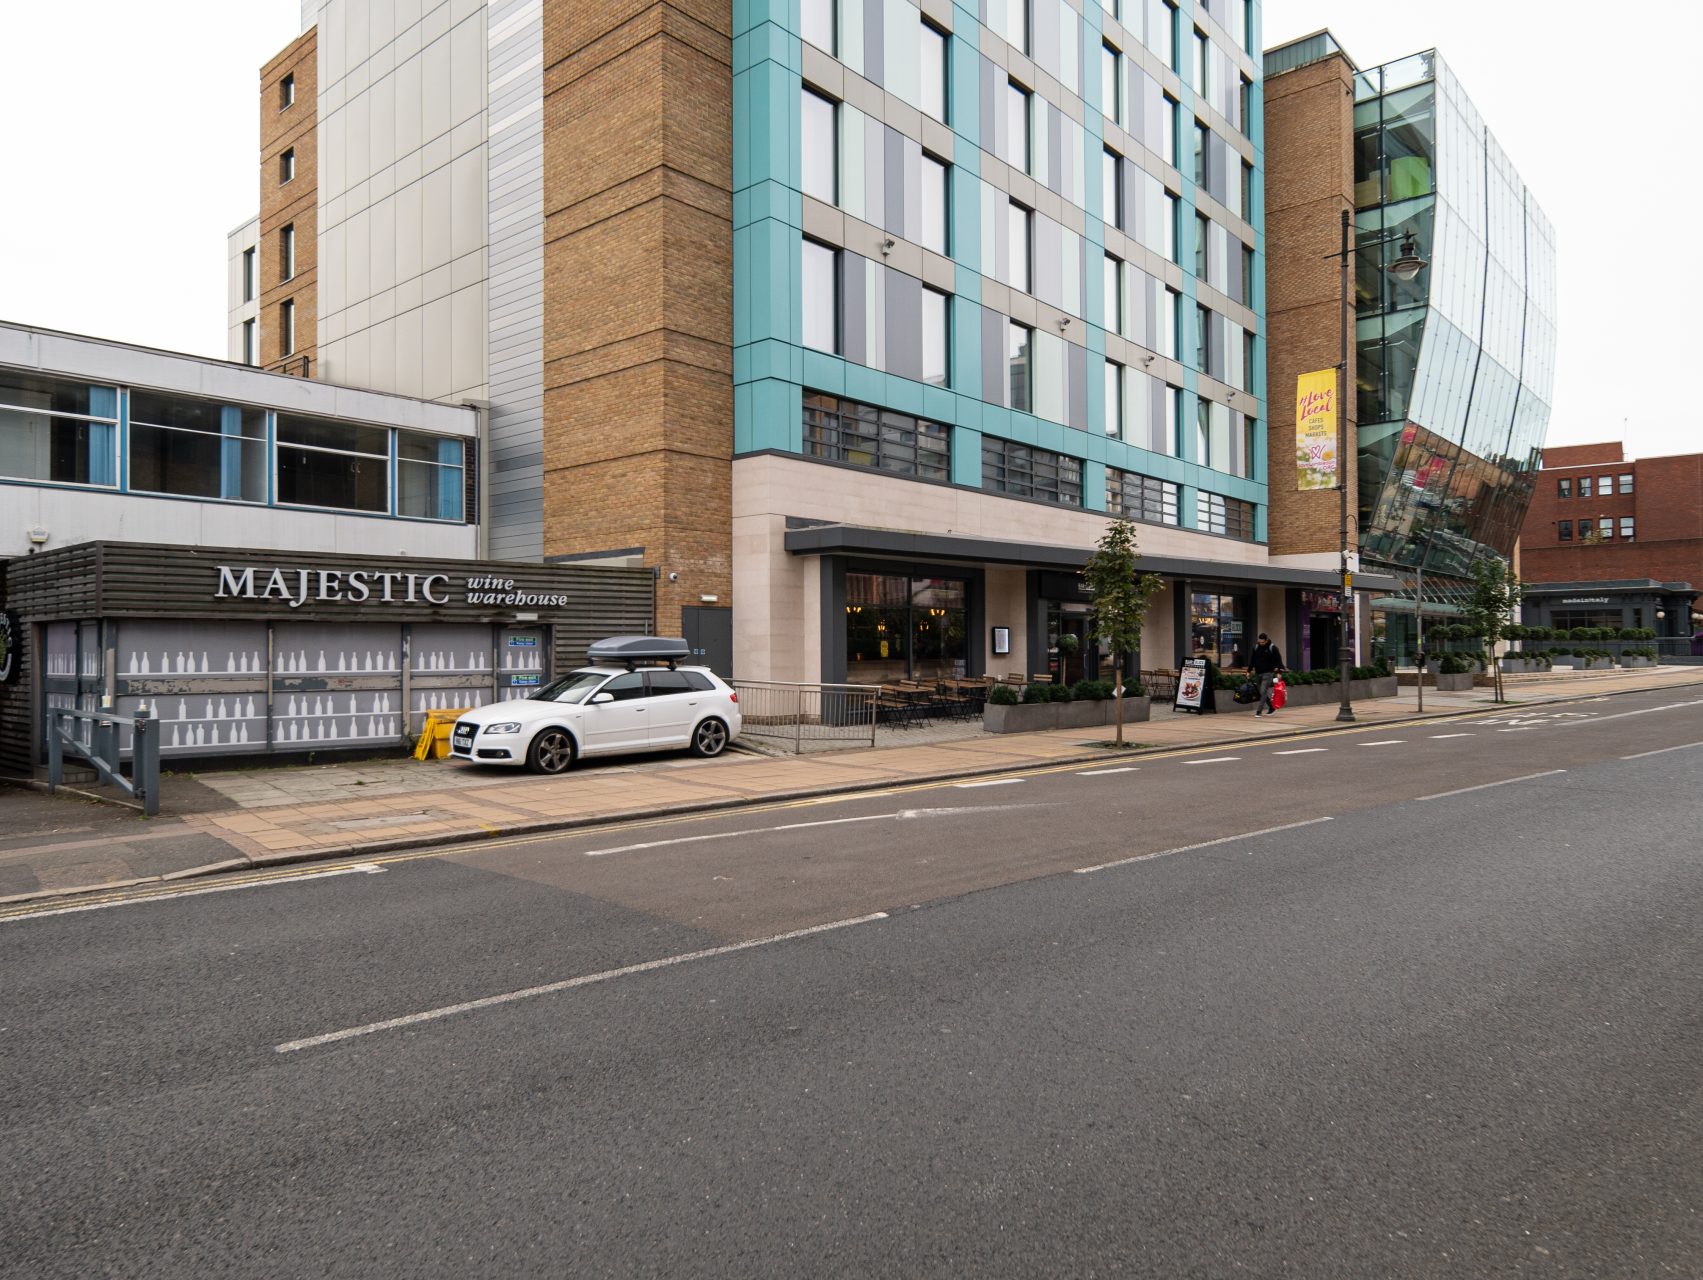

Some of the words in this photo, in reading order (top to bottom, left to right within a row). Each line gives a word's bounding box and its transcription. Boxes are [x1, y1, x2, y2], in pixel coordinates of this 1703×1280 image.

[1299, 388, 1334, 408] #Love
[1300, 397, 1333, 421] Local
[214, 565, 450, 608] MAJESTIC
[466, 574, 514, 591] wine
[466, 589, 568, 607] warehouse
